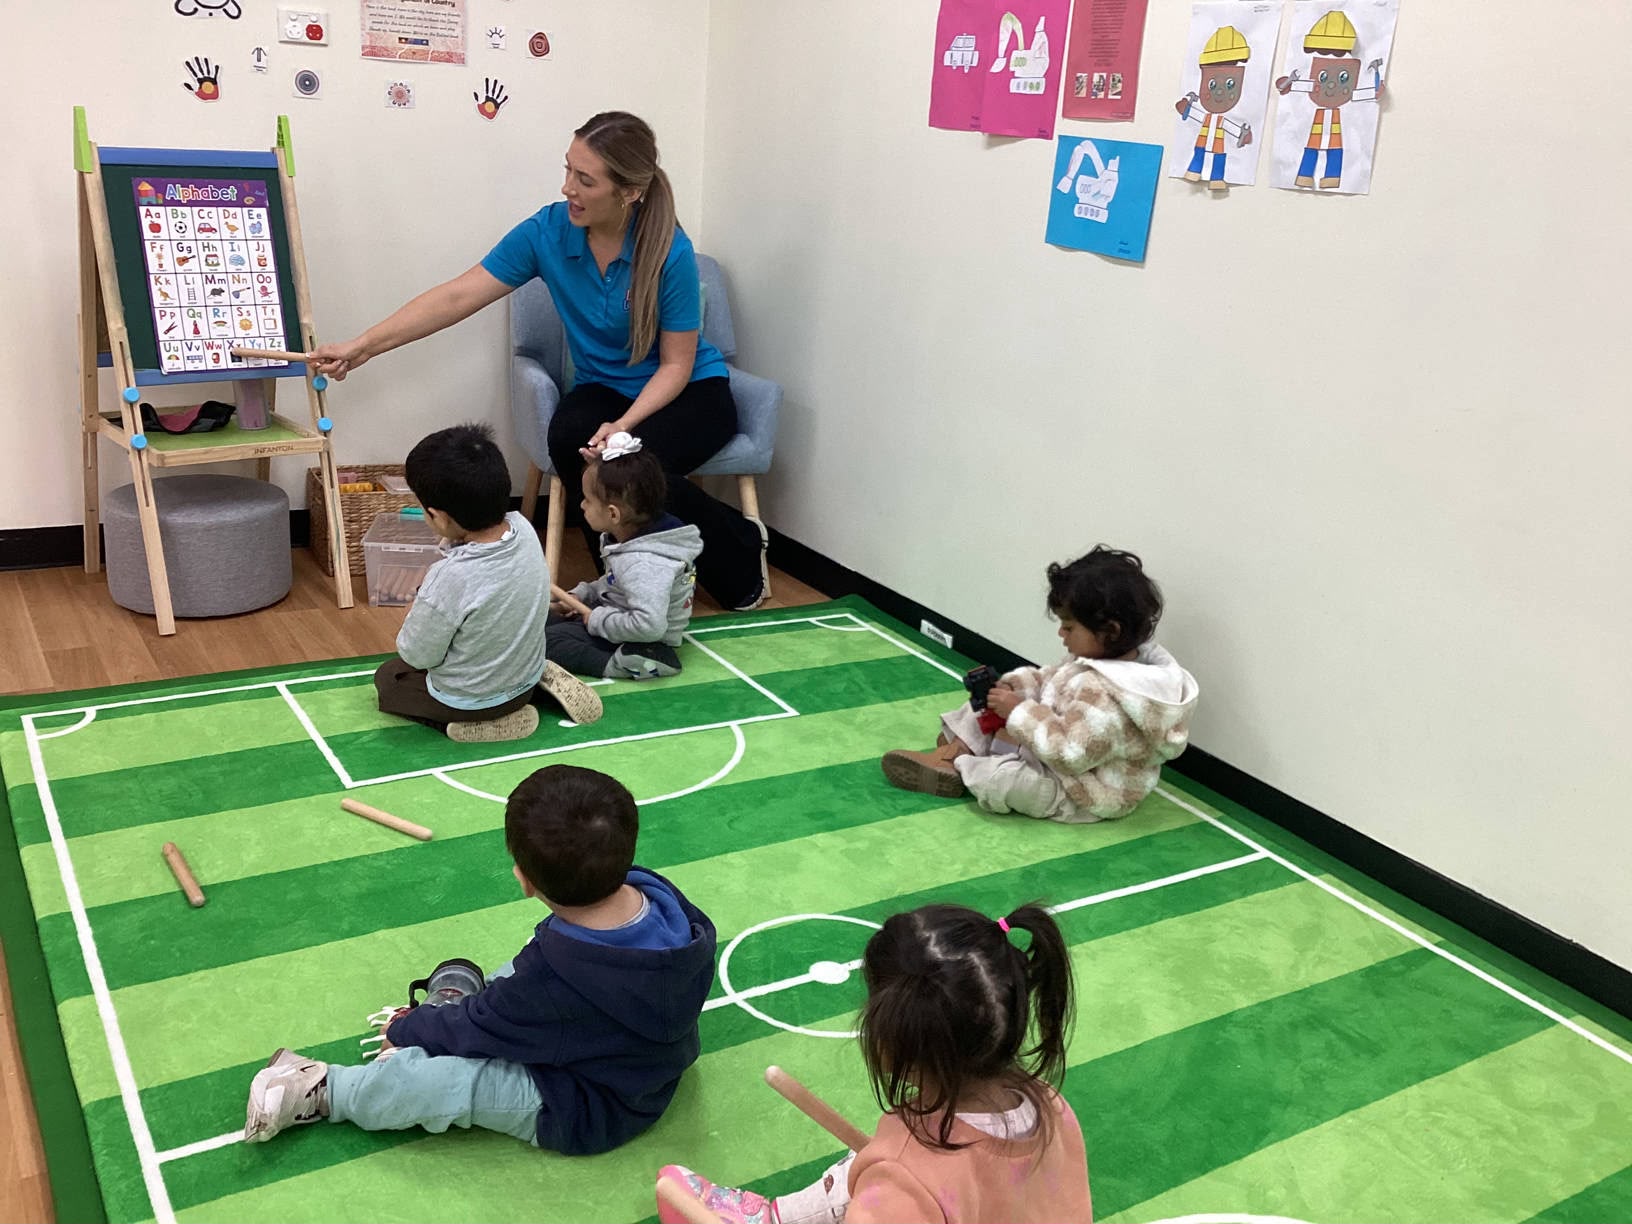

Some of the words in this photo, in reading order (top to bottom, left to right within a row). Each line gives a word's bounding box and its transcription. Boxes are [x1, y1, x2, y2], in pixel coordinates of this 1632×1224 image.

[166, 184, 237, 203] Alphabet
[145, 208, 161, 219] Aa
[171, 208, 187, 219] Bb
[223, 209, 237, 219] Dd
[248, 209, 262, 219] Ee
[176, 242, 192, 254] Gg
[202, 242, 217, 252] Hh
[154, 275, 171, 286] Kk
[205, 274, 226, 285] Mm
[232, 274, 247, 284] Nn
[159, 310, 176, 320] Pp
[213, 308, 227, 318] Rr
[163, 342, 179, 352] Uu
[204, 341, 222, 351] Ww
